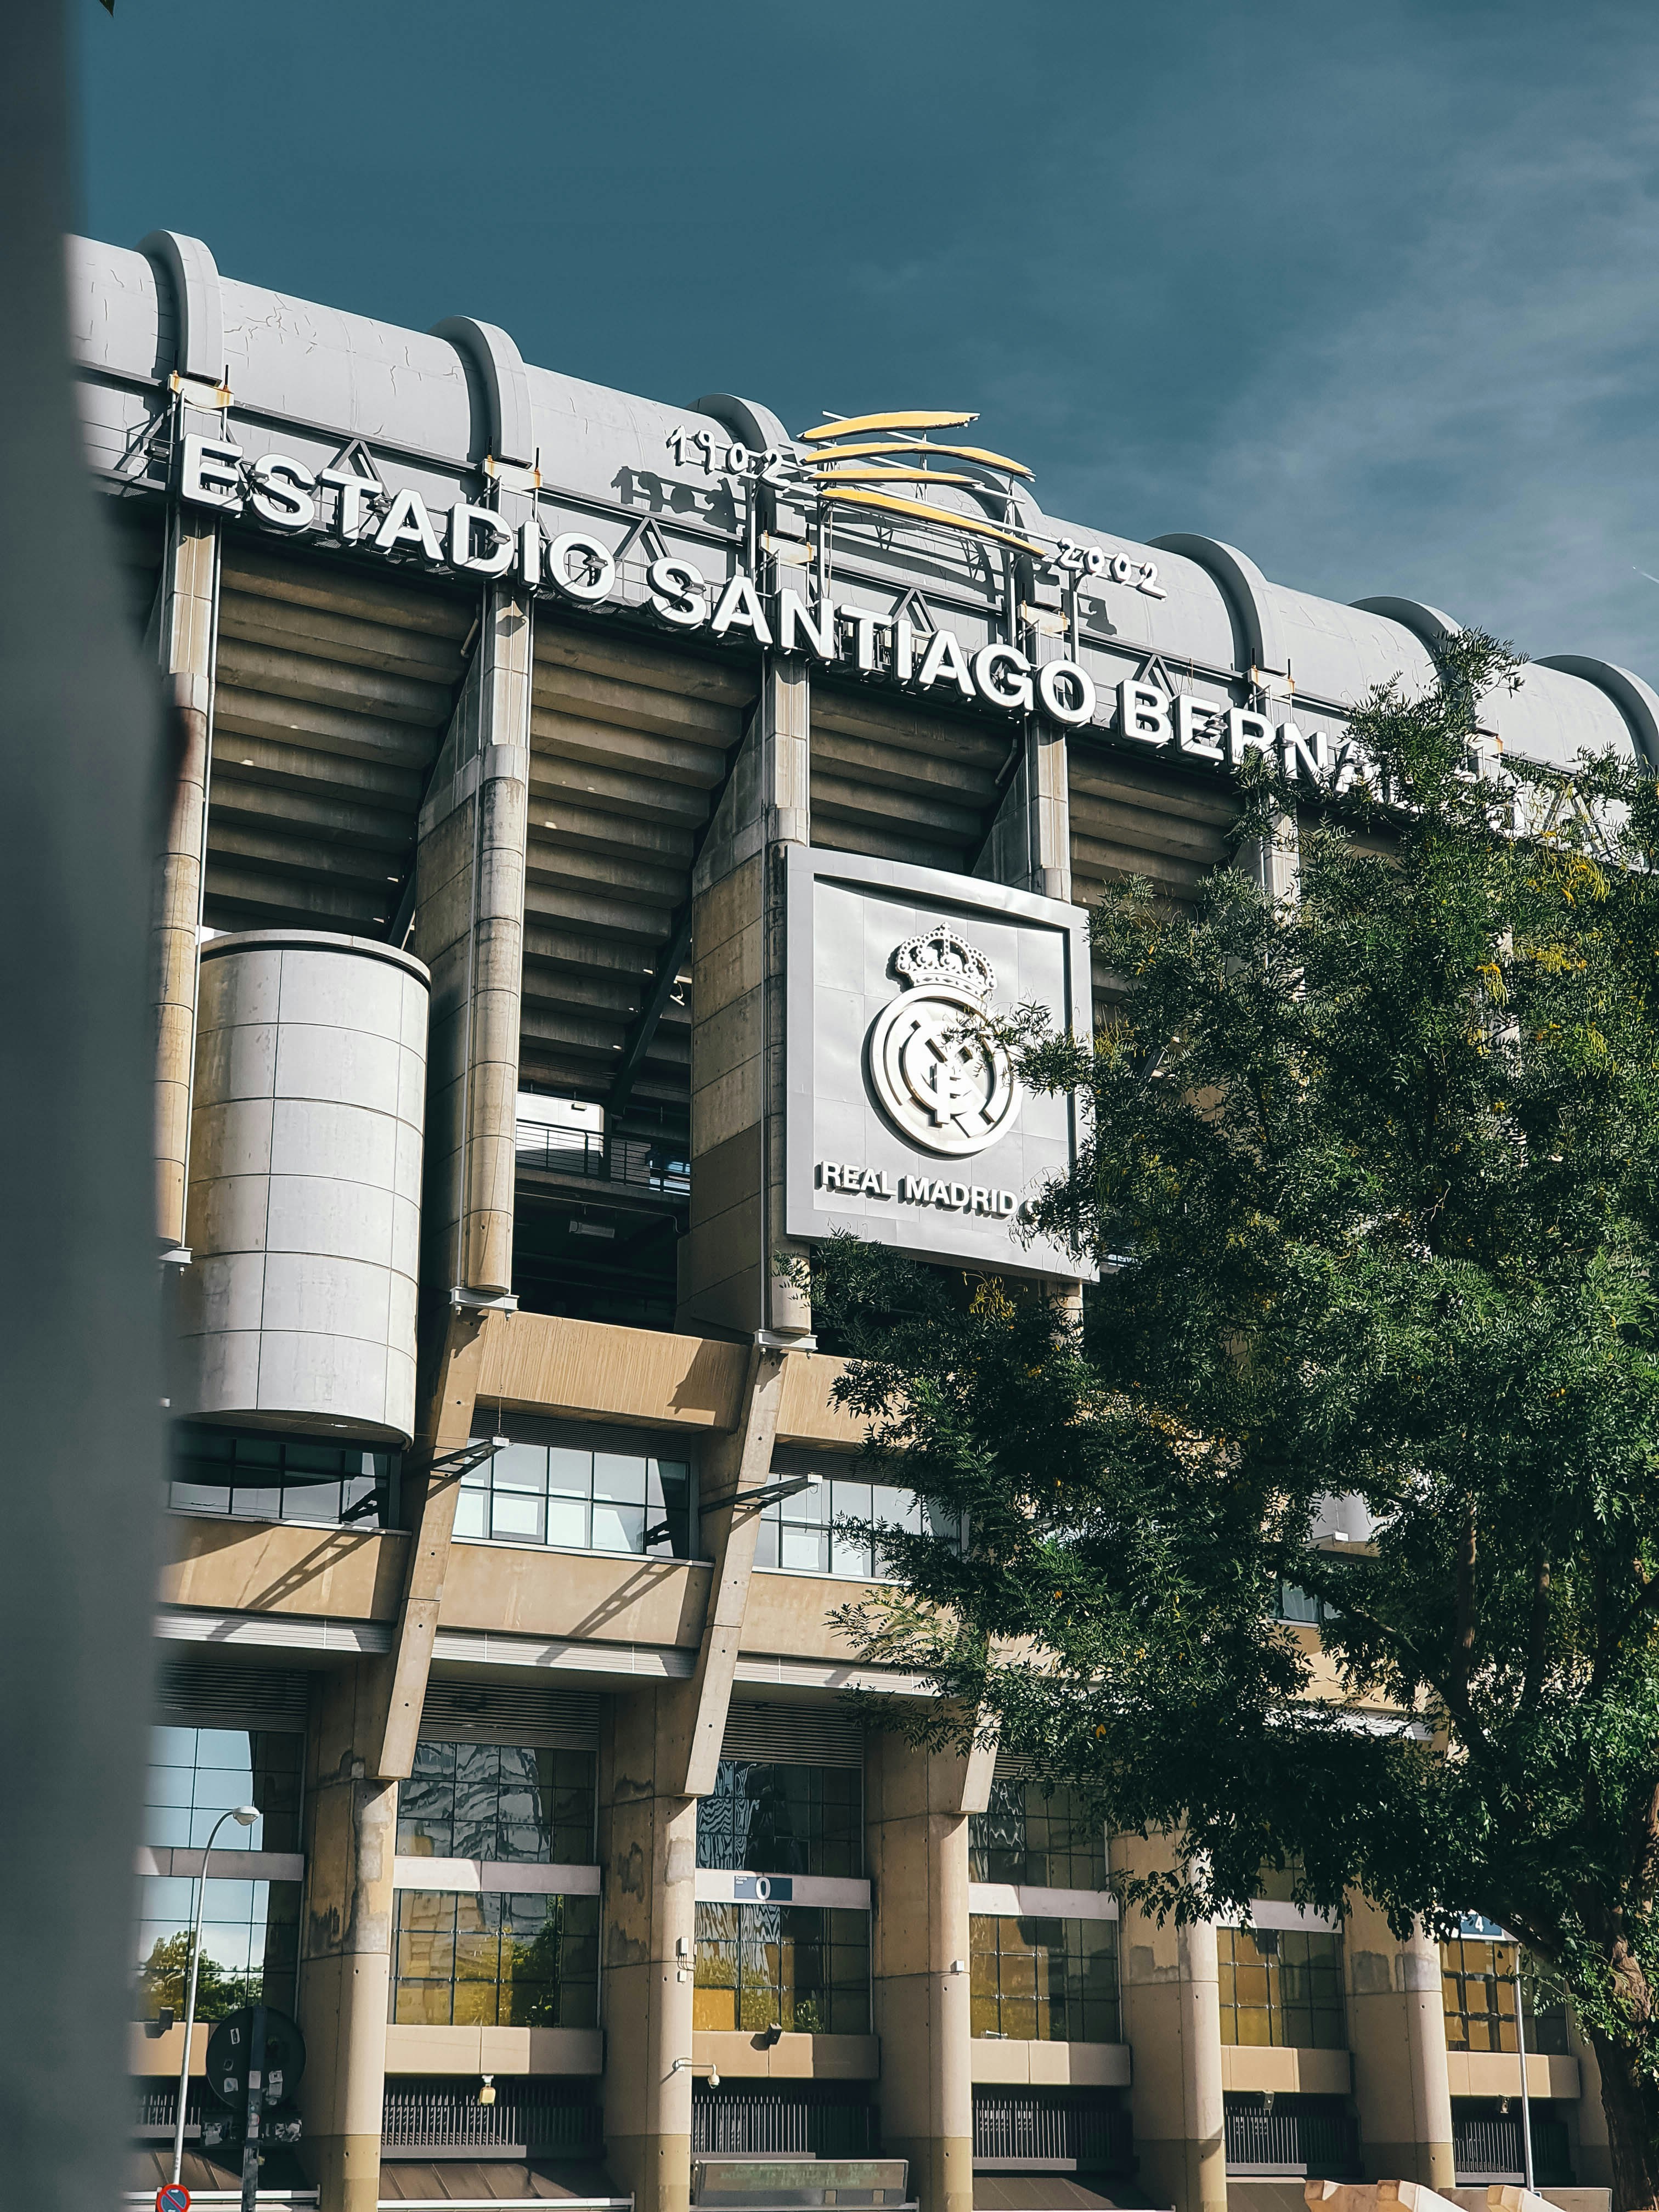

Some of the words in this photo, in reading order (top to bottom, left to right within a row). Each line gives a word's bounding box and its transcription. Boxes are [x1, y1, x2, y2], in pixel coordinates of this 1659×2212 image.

[666, 425, 791, 490] 1902
[181, 432, 616, 602] ESTADIO
[647, 557, 1096, 725] SANTIAGO
[1058, 537, 1168, 601] 2002
[821, 1160, 897, 1197] REAL
[904, 1174, 1018, 1215] MADRID
[755, 1877, 771, 1900] 0
[1475, 1914, 1484, 1932] 4
